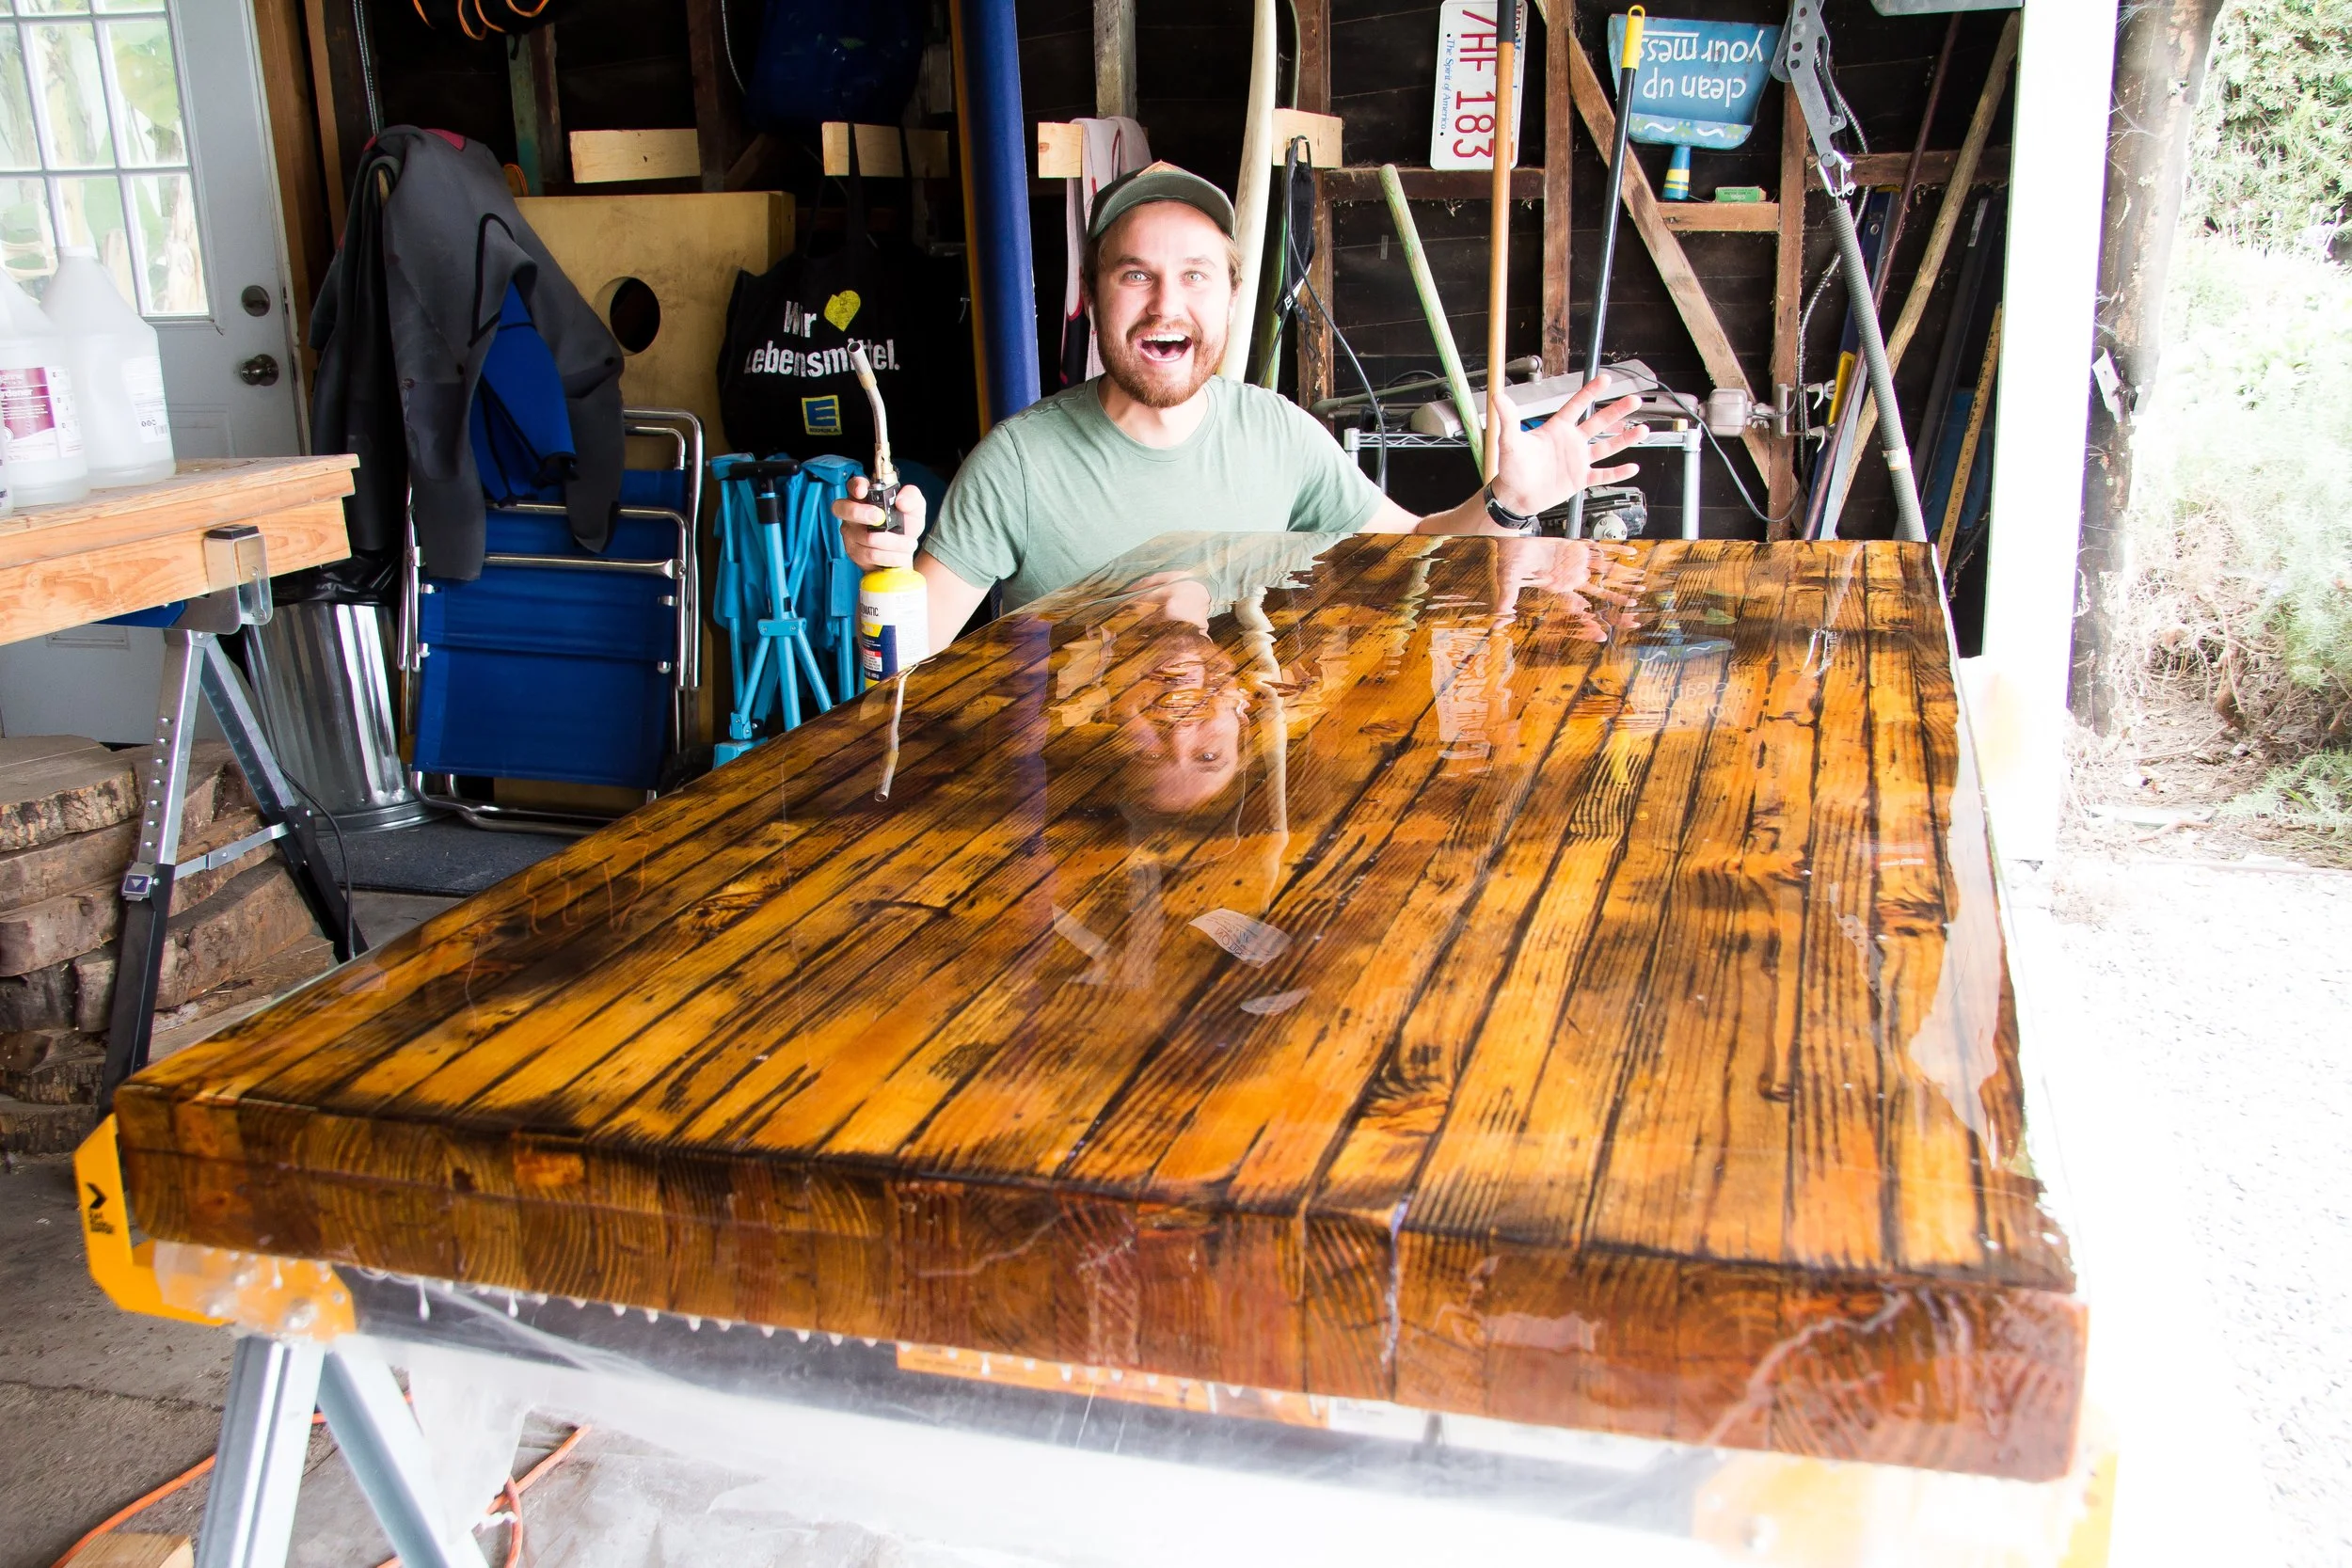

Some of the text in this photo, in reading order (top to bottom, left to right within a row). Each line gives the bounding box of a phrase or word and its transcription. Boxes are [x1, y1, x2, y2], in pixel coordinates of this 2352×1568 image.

[1701, 29, 1765, 63] your
[1440, 40, 1454, 130] The Spirit of America
[1642, 67, 1746, 107] clean up
[1453, 90, 1496, 158] 183
[783, 300, 817, 338] Wir
[743, 338, 900, 377] Lebensmtel.
